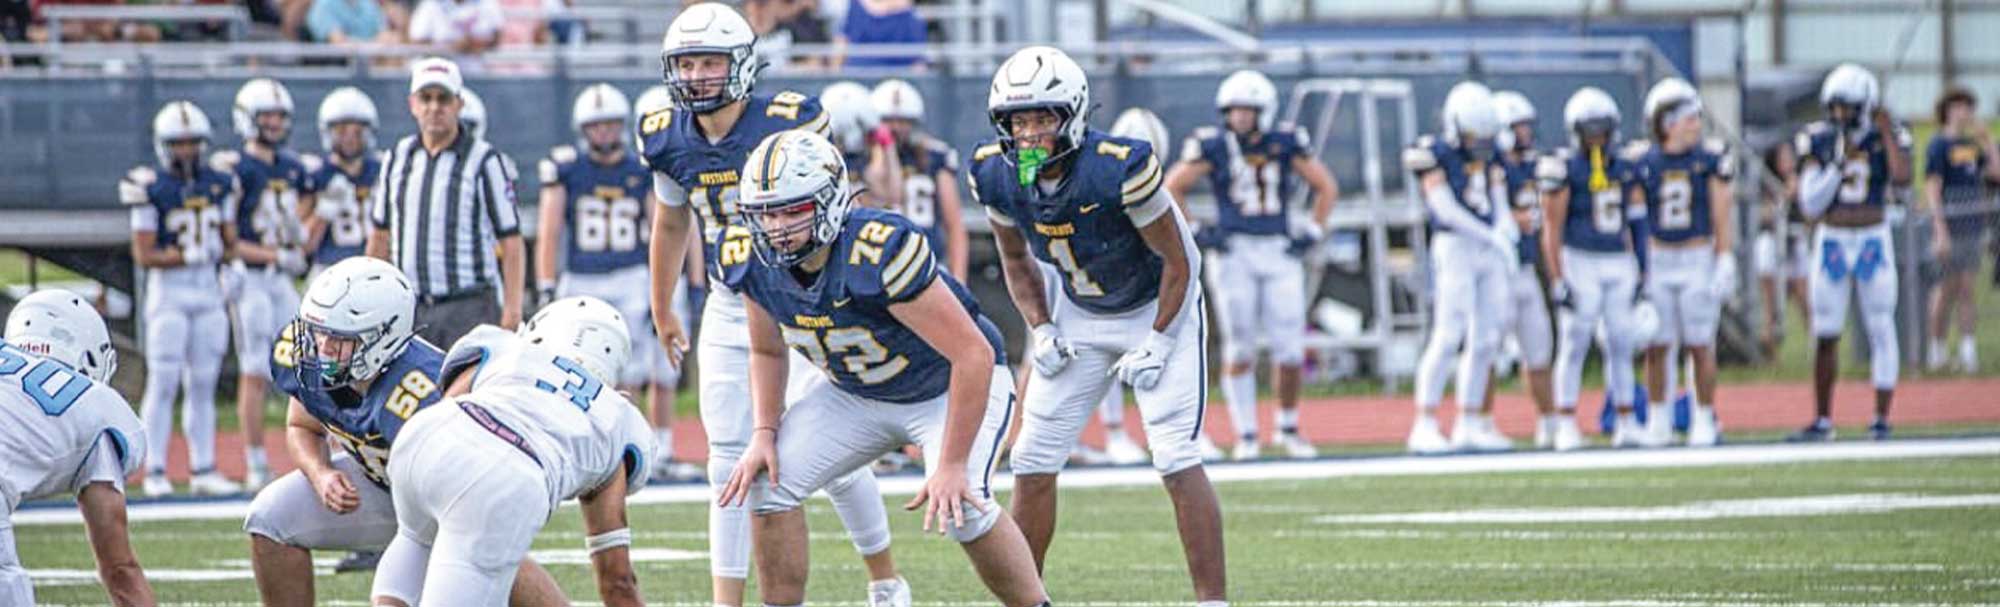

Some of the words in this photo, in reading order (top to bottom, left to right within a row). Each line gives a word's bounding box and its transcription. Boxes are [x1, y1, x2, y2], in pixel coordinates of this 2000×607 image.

[1097, 141, 1131, 160] 1
[576, 195, 640, 251] 66
[1660, 178, 1691, 229] 2
[849, 220, 896, 265] 72
[1048, 238, 1105, 296] 1
[779, 325, 910, 385] 72
[385, 369, 438, 420] 58
